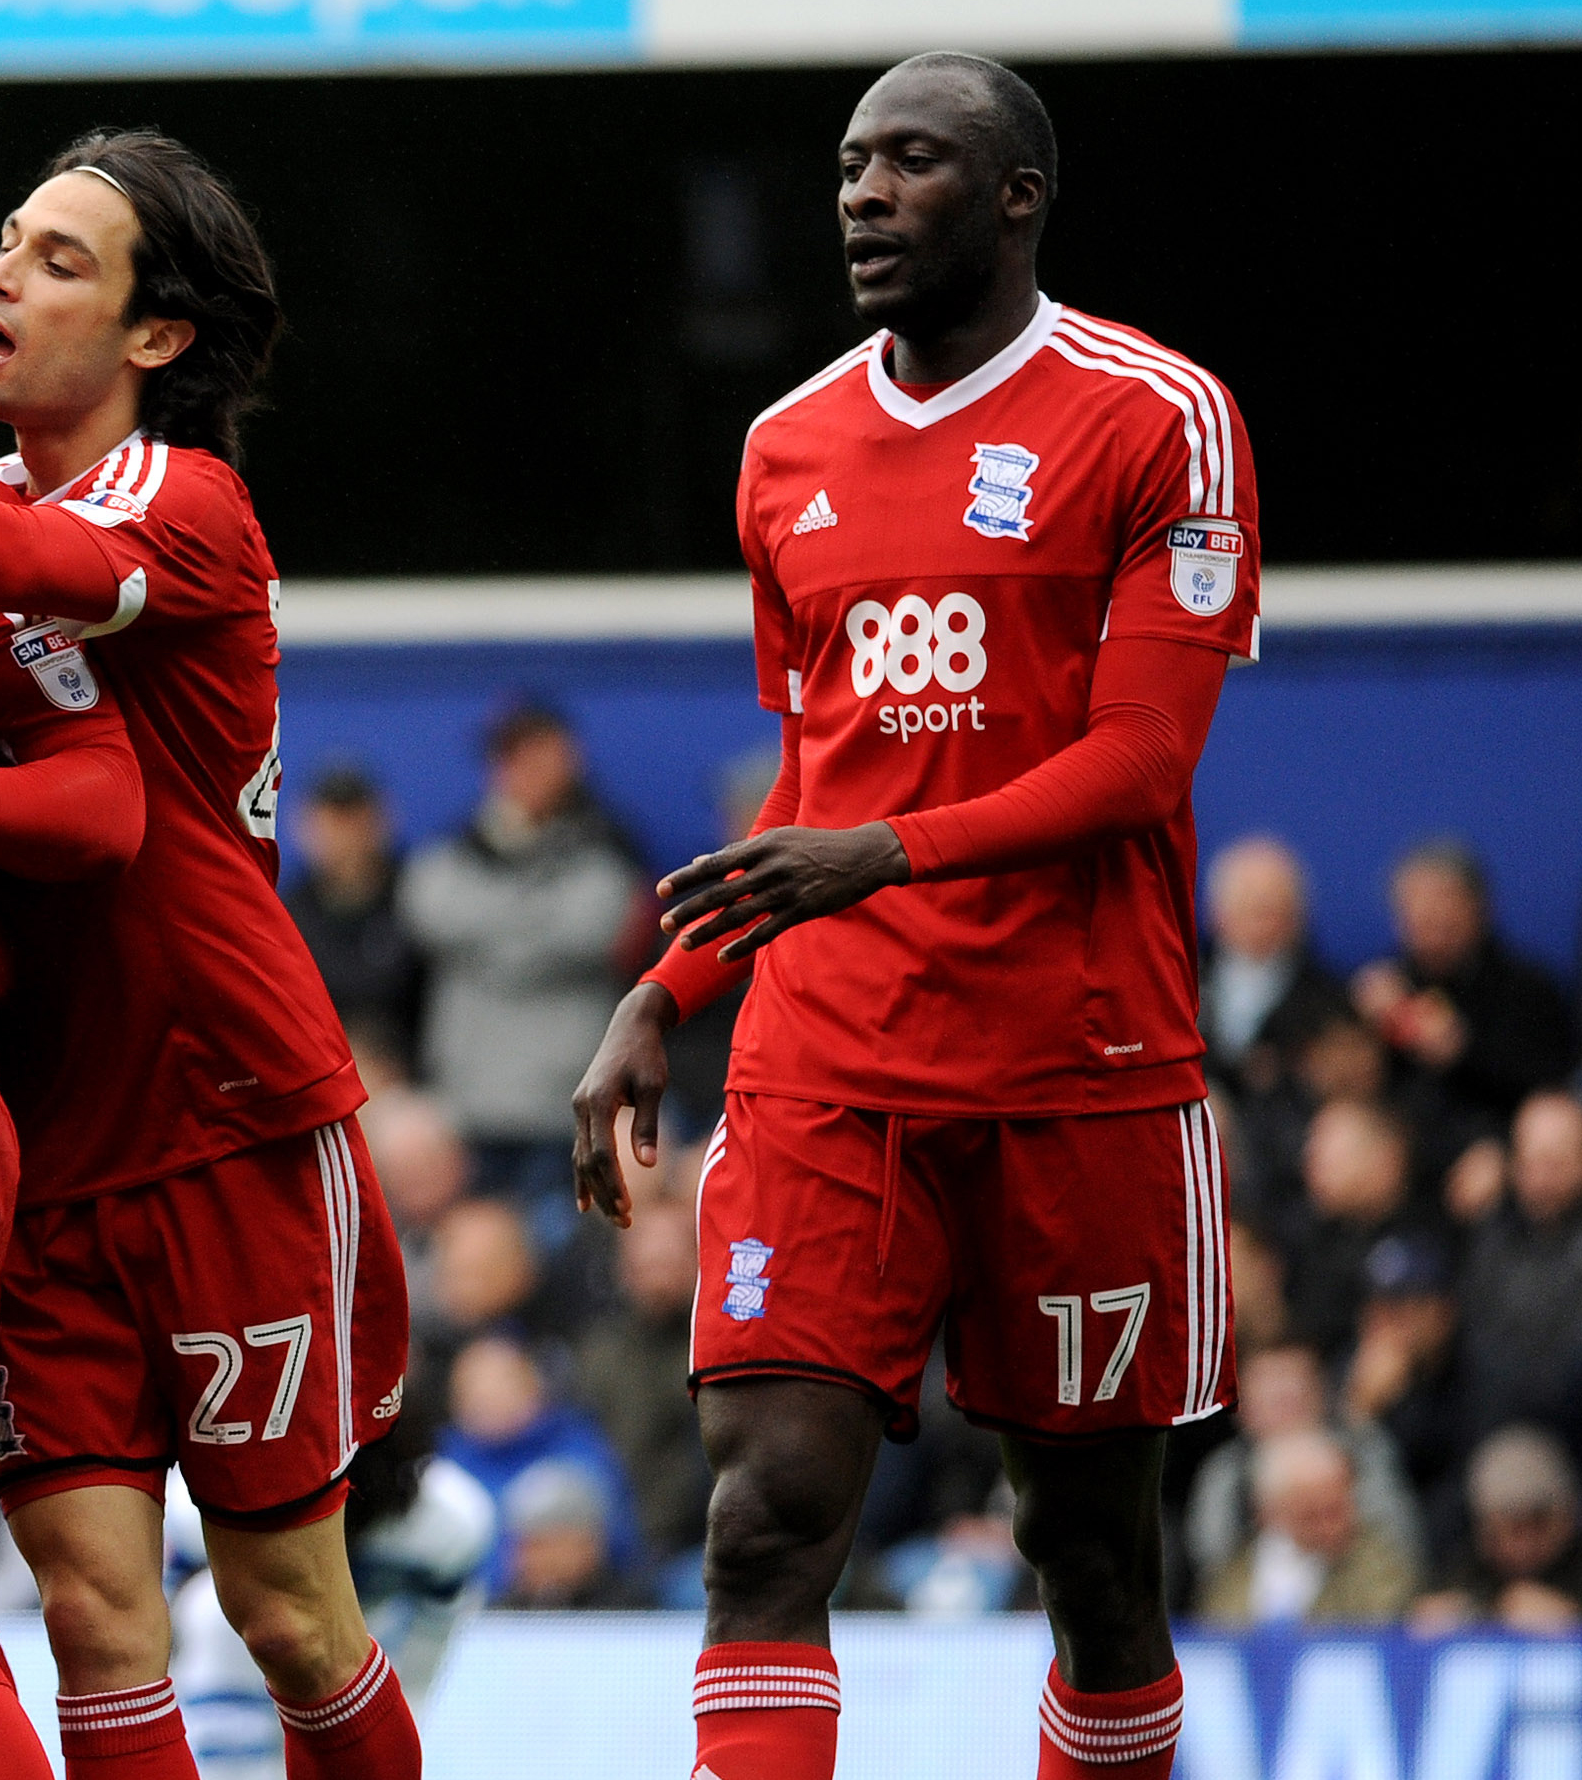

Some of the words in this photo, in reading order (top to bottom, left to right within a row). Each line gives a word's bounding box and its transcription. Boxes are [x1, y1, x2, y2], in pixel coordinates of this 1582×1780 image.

[792, 512, 838, 535] adidas
[1173, 528, 1204, 549] sky
[1210, 533, 1239, 551] BET
[1193, 594, 1213, 606] EFL
[18, 640, 45, 661] sky
[846, 592, 988, 698] 888
[70, 688, 90, 702] EFL
[879, 696, 986, 744] sport
[1037, 1281, 1150, 1406] 17
[172, 1313, 312, 1444] 27
